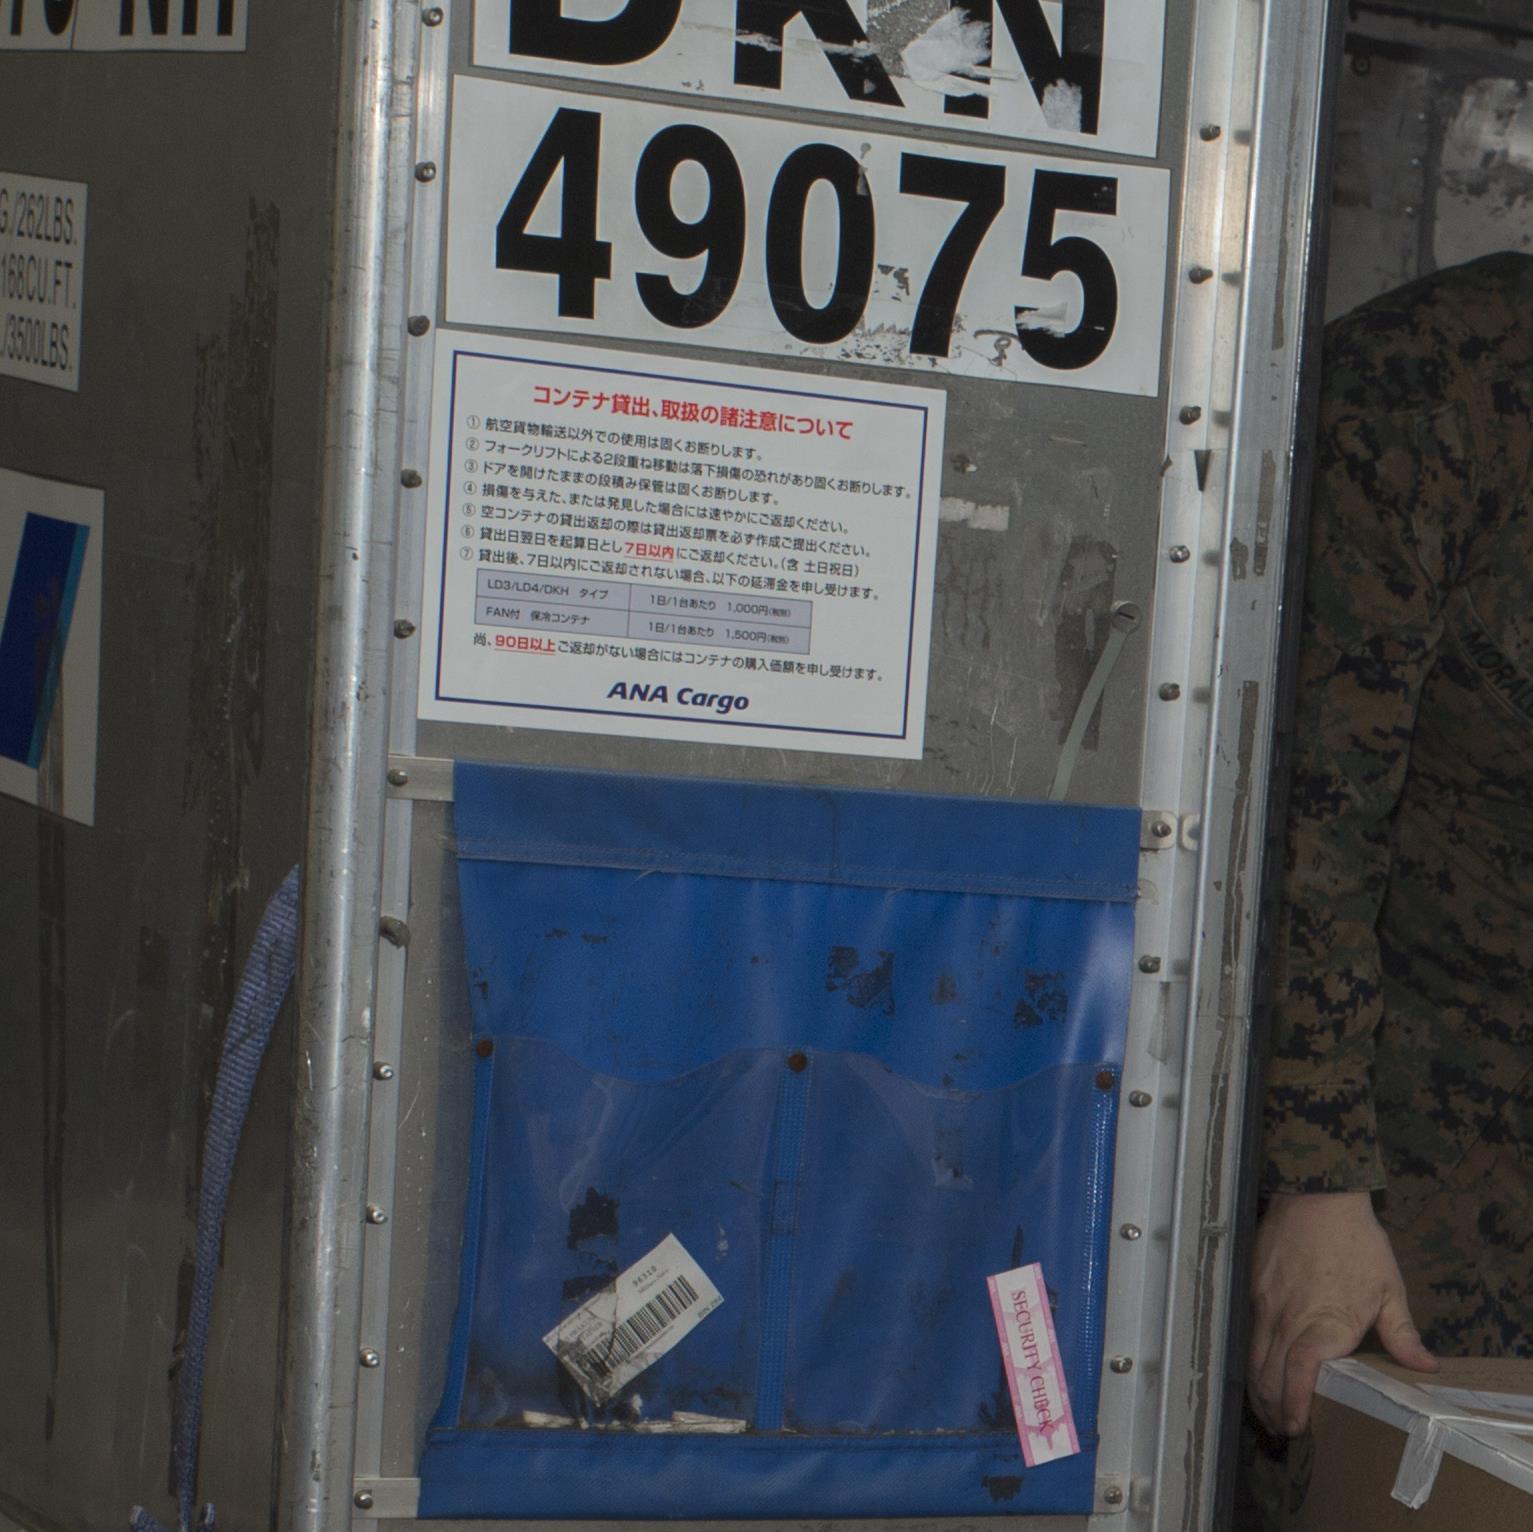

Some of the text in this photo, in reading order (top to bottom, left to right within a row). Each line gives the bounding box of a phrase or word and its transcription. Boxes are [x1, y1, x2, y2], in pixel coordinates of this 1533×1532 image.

[496, 107, 1118, 370] 49075
[533, 385, 853, 440] コンテナ貸出、取扱の諸注意について
[487, 579, 608, 600] LD3/LD4/DKH タイプ
[531, 610, 590, 626] 保冷コンテナ
[607, 681, 750, 714] ANA Cargo
[1011, 1289, 1055, 1434] SECURITY CHECK
